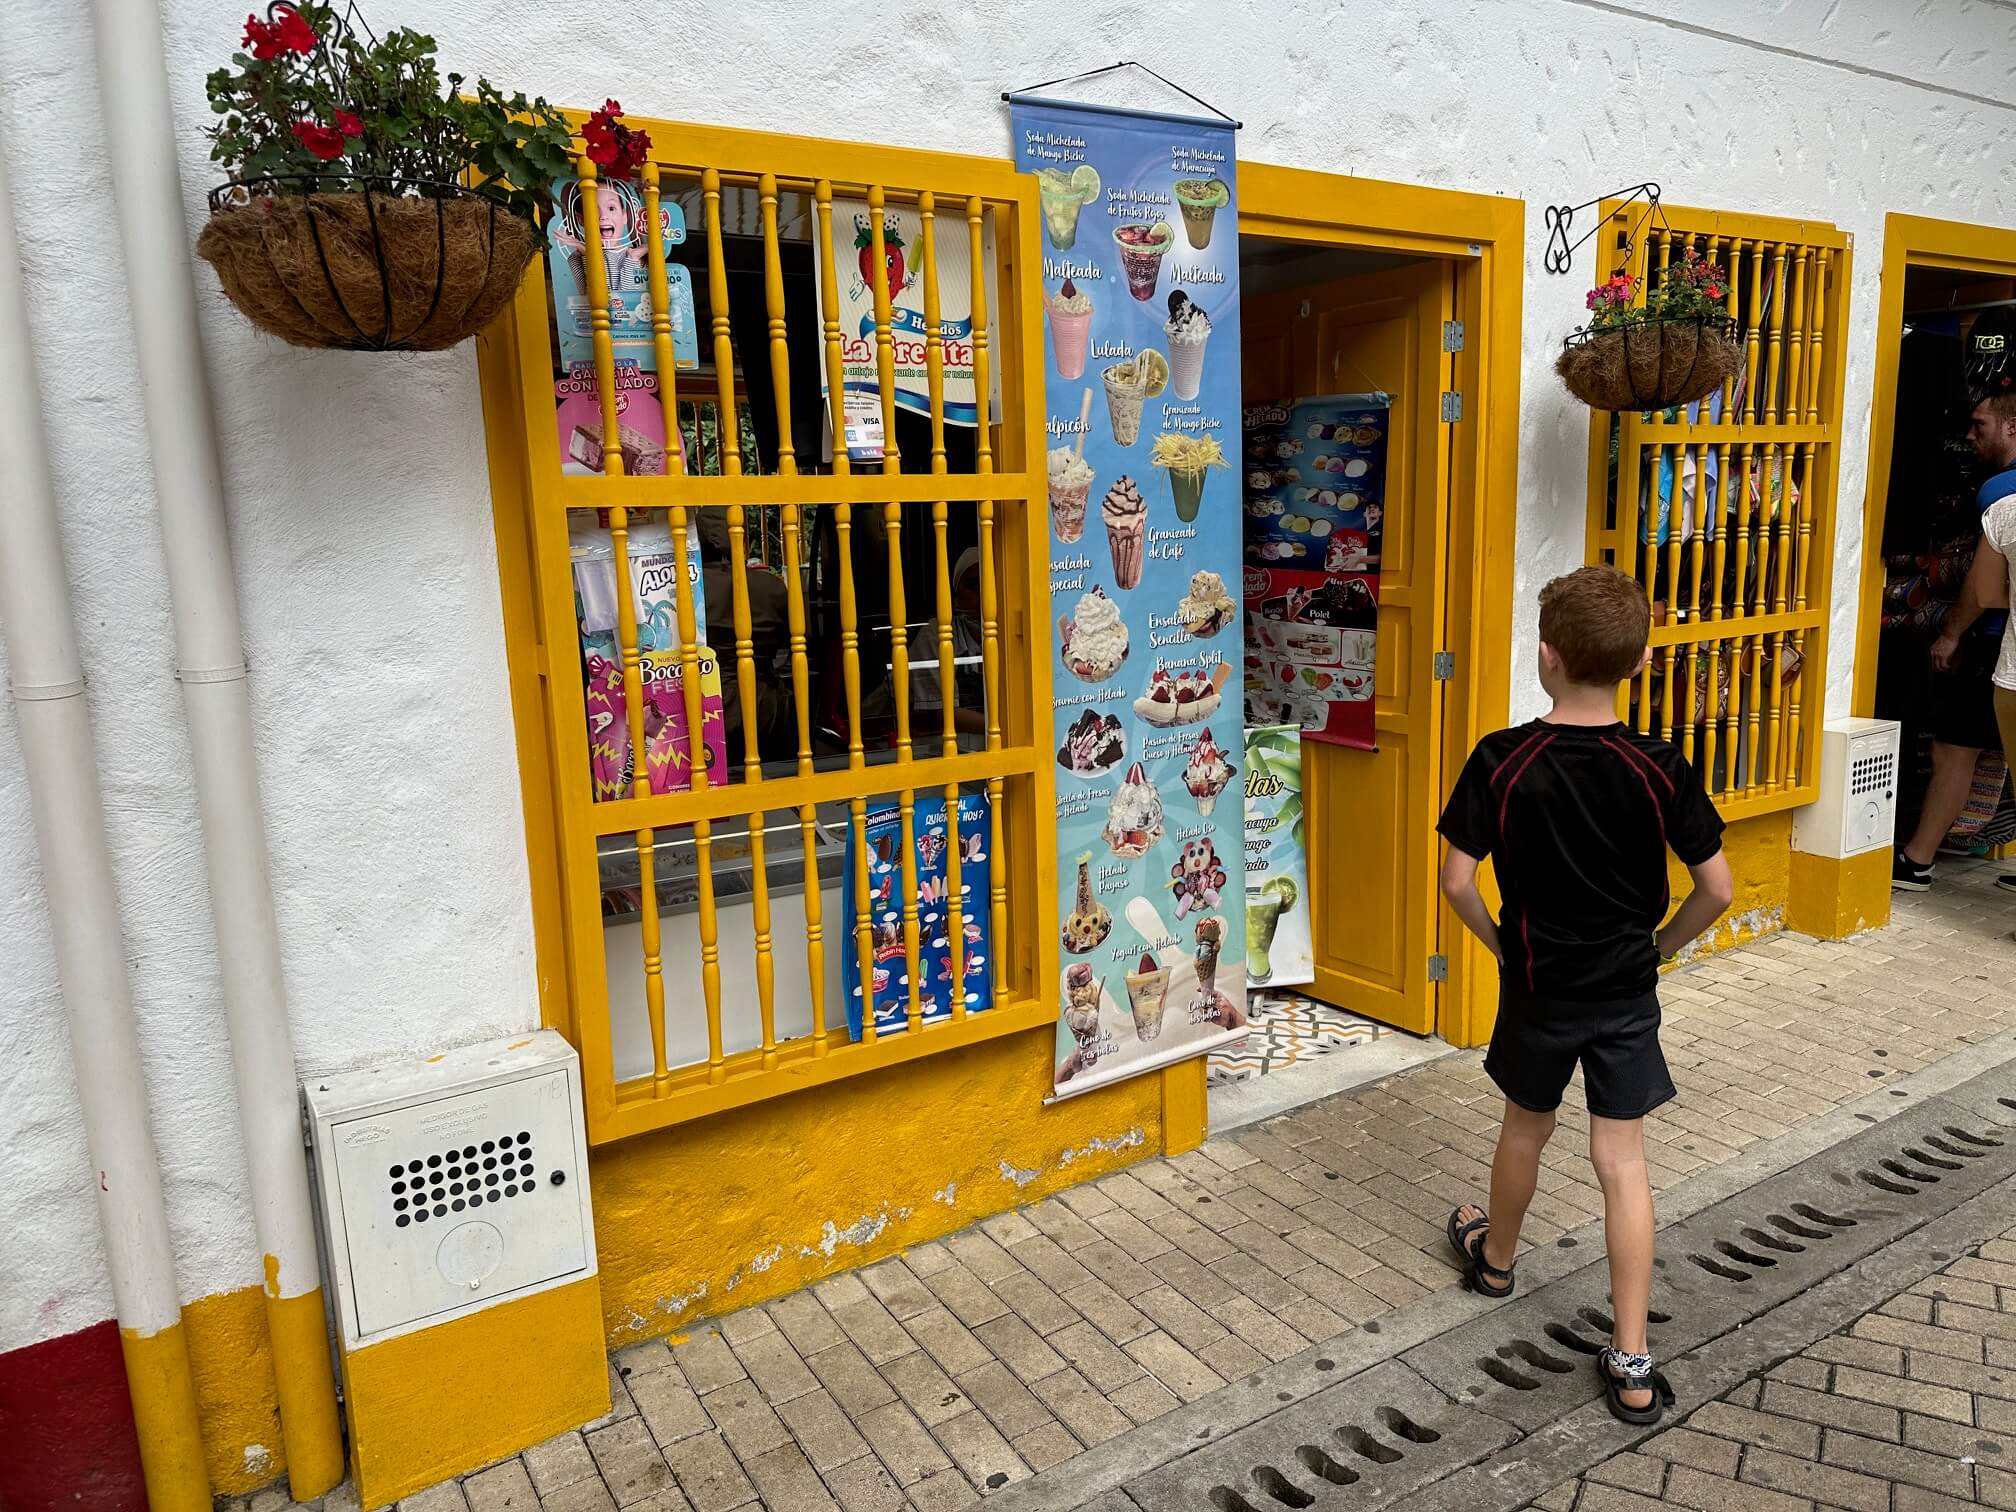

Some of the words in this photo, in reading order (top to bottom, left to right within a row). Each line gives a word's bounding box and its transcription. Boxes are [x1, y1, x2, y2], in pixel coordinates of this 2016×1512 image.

[1026, 130, 1045, 143] Soda
[1047, 132, 1087, 148] Michelada
[1027, 147, 1036, 156] de
[1037, 148, 1062, 163] Mango
[1063, 149, 1086, 162] Biche
[1171, 146, 1189, 160] Soda
[1191, 147, 1226, 163] Michelada
[1171, 160, 1181, 171] de
[1107, 188, 1127, 203] Soda
[1130, 189, 1171, 205] Michelada
[1107, 204, 1118, 216] de
[1119, 205, 1142, 218] Frutos
[1144, 207, 1166, 220] Rojos
[1043, 256, 1103, 279] Malteada
[1170, 263, 1225, 284] Malteada
[634, 275, 682, 285] DIVIDO
[911, 315, 962, 336] Hedos
[1090, 338, 1133, 359] Lulada
[573, 366, 636, 380] GALTA
[848, 367, 874, 378] antojo
[559, 381, 592, 393] CON
[597, 377, 655, 391] LADO
[1162, 402, 1201, 416] Granizado
[862, 417, 880, 425] VISA
[1046, 416, 1091, 438] alpicón
[1162, 418, 1173, 430] de
[1174, 418, 1199, 431] Mango
[1200, 416, 1221, 429] Biche
[1148, 526, 1197, 545] Granizado
[1148, 544, 1161, 559] de
[1162, 544, 1184, 561] Café
[1049, 553, 1092, 574] nsalada
[1049, 574, 1085, 596] special
[1149, 610, 1198, 630] Ensalada
[1149, 631, 1193, 649] Sencilla
[1156, 655, 1197, 673] Banana
[1199, 650, 1222, 665] Split
[1081, 695, 1095, 703] con
[1098, 686, 1126, 702] Helado
[1169, 732, 1177, 742] de
[1178, 731, 1200, 742] Fresas
[1142, 749, 1164, 761] Queso
[1165, 750, 1170, 760] y
[1172, 742, 1196, 758] Helado
[1087, 788, 1110, 800] Fresas
[1064, 802, 1089, 817] Helado
[1244, 816, 1278, 831] acuya
[1176, 826, 1201, 842] Helado
[1244, 838, 1271, 854] ango
[1098, 863, 1127, 881] Helado
[1098, 878, 1129, 895] Payaso
[1111, 943, 1137, 961] Yogurt
[1154, 932, 1183, 951] Helado
[1080, 1034, 1100, 1049] Cono
